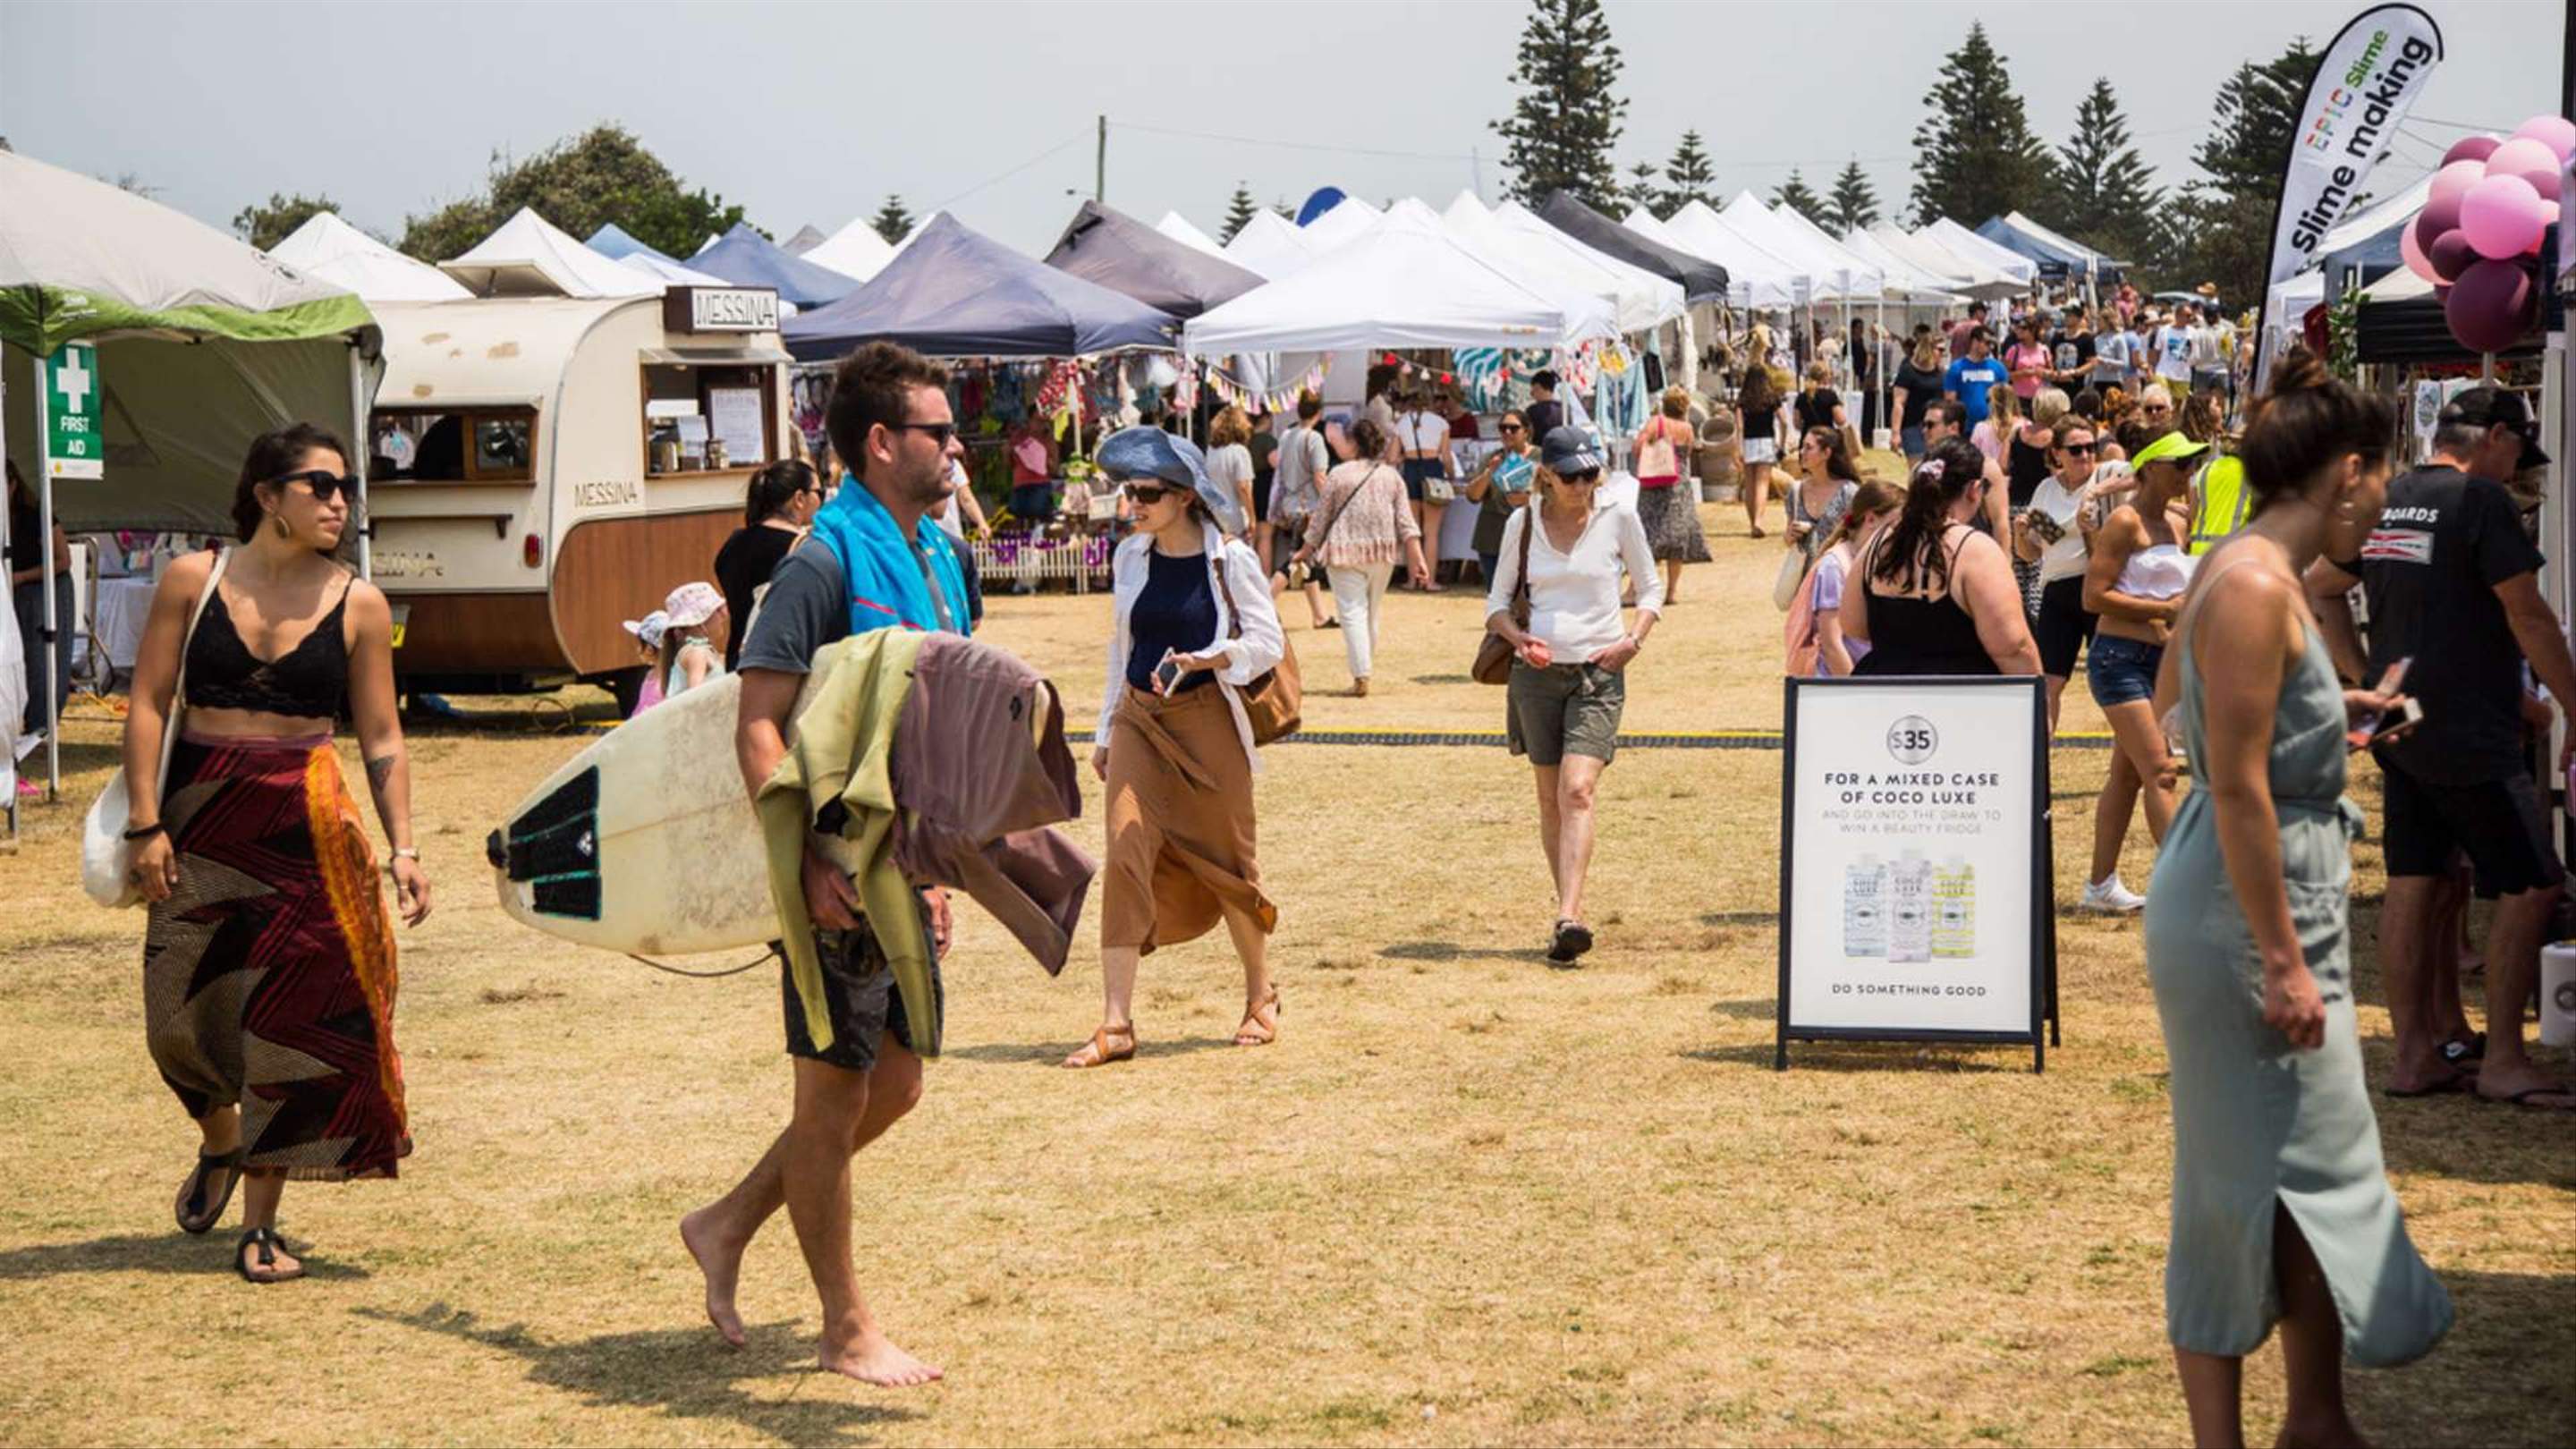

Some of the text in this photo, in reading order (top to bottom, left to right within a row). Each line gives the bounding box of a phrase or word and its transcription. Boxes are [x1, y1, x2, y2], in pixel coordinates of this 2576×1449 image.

[2305, 30, 2389, 151] EPIC Slime
[2292, 36, 2434, 254] Slime making
[696, 293, 775, 326] MESSINA
[59, 416, 89, 433] FIRST
[67, 439, 87, 456] AID
[573, 481, 639, 508] MESSINA
[1890, 729, 1931, 750] $35
[1824, 772, 2000, 786] FOR A MIXED CASE
[1840, 791, 1976, 805] OF COCO LUXE
[1822, 809, 2002, 821] AND GO INTO THE DRAW TO
[1840, 823, 1982, 835] WIN A BEAUTY FRIDGE
[1832, 984, 1987, 997] DO SOMETHING GOOD
